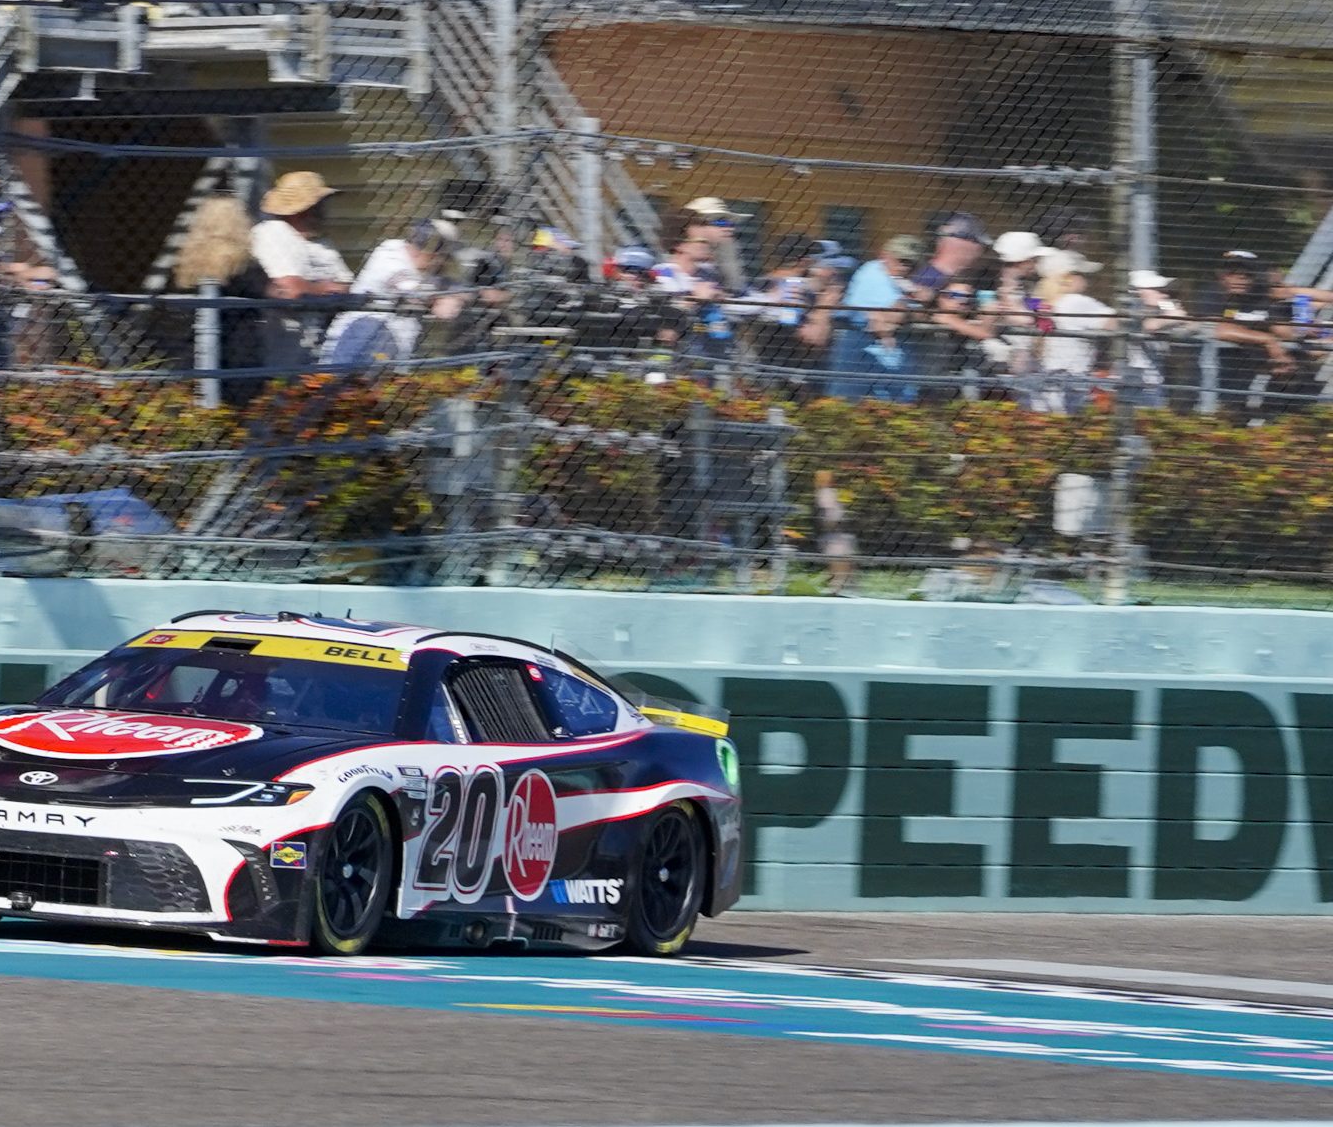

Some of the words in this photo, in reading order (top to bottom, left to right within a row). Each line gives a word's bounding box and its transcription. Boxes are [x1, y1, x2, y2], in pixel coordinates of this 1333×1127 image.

[324, 645, 394, 664] BELL
[337, 764, 394, 783] GOODYEAR
[413, 764, 502, 900] 20
[274, 850, 304, 860] SUNOCO
[563, 878, 624, 905] WATTS
